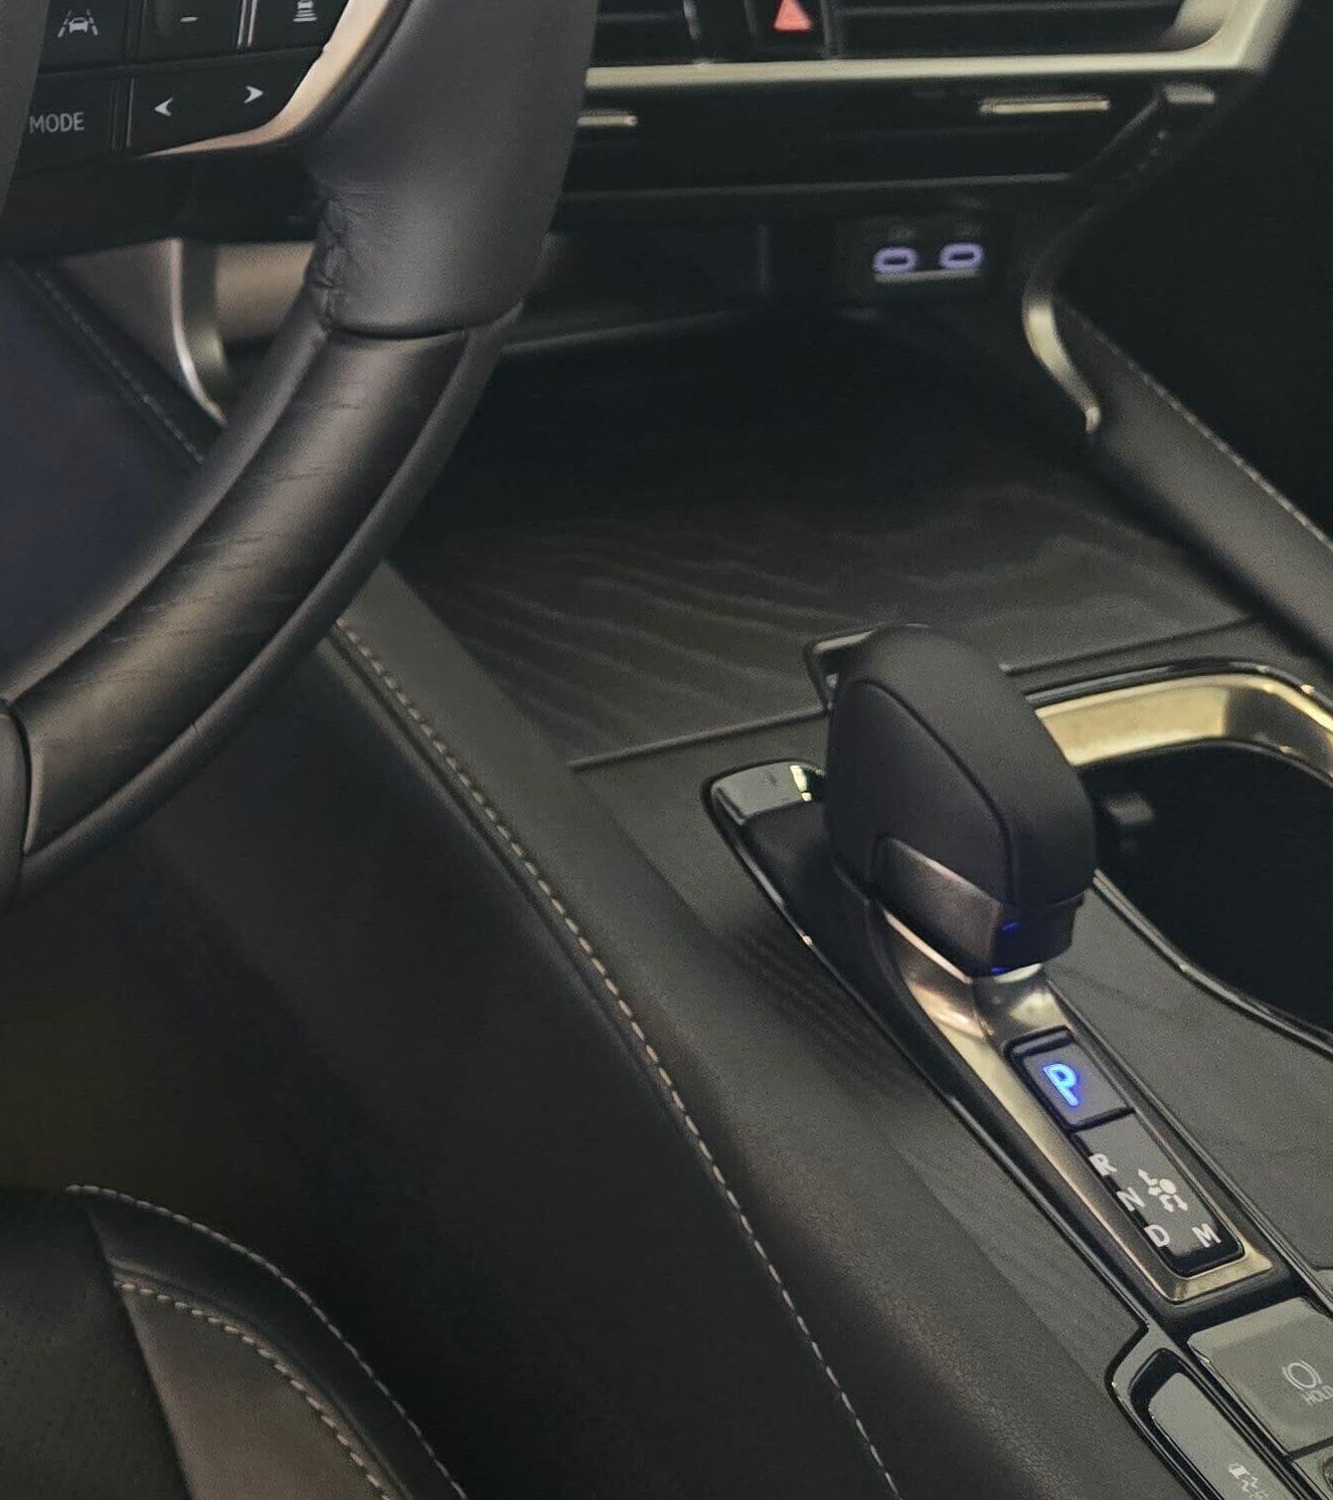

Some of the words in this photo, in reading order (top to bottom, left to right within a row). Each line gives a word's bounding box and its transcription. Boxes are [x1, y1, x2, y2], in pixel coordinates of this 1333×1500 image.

[29, 112, 85, 135] MODE
[1043, 1062, 1081, 1108] P
[1089, 1152, 1118, 1179] R
[1117, 1187, 1144, 1212] N
[1144, 1224, 1171, 1248] D
[1191, 1224, 1222, 1248] M
